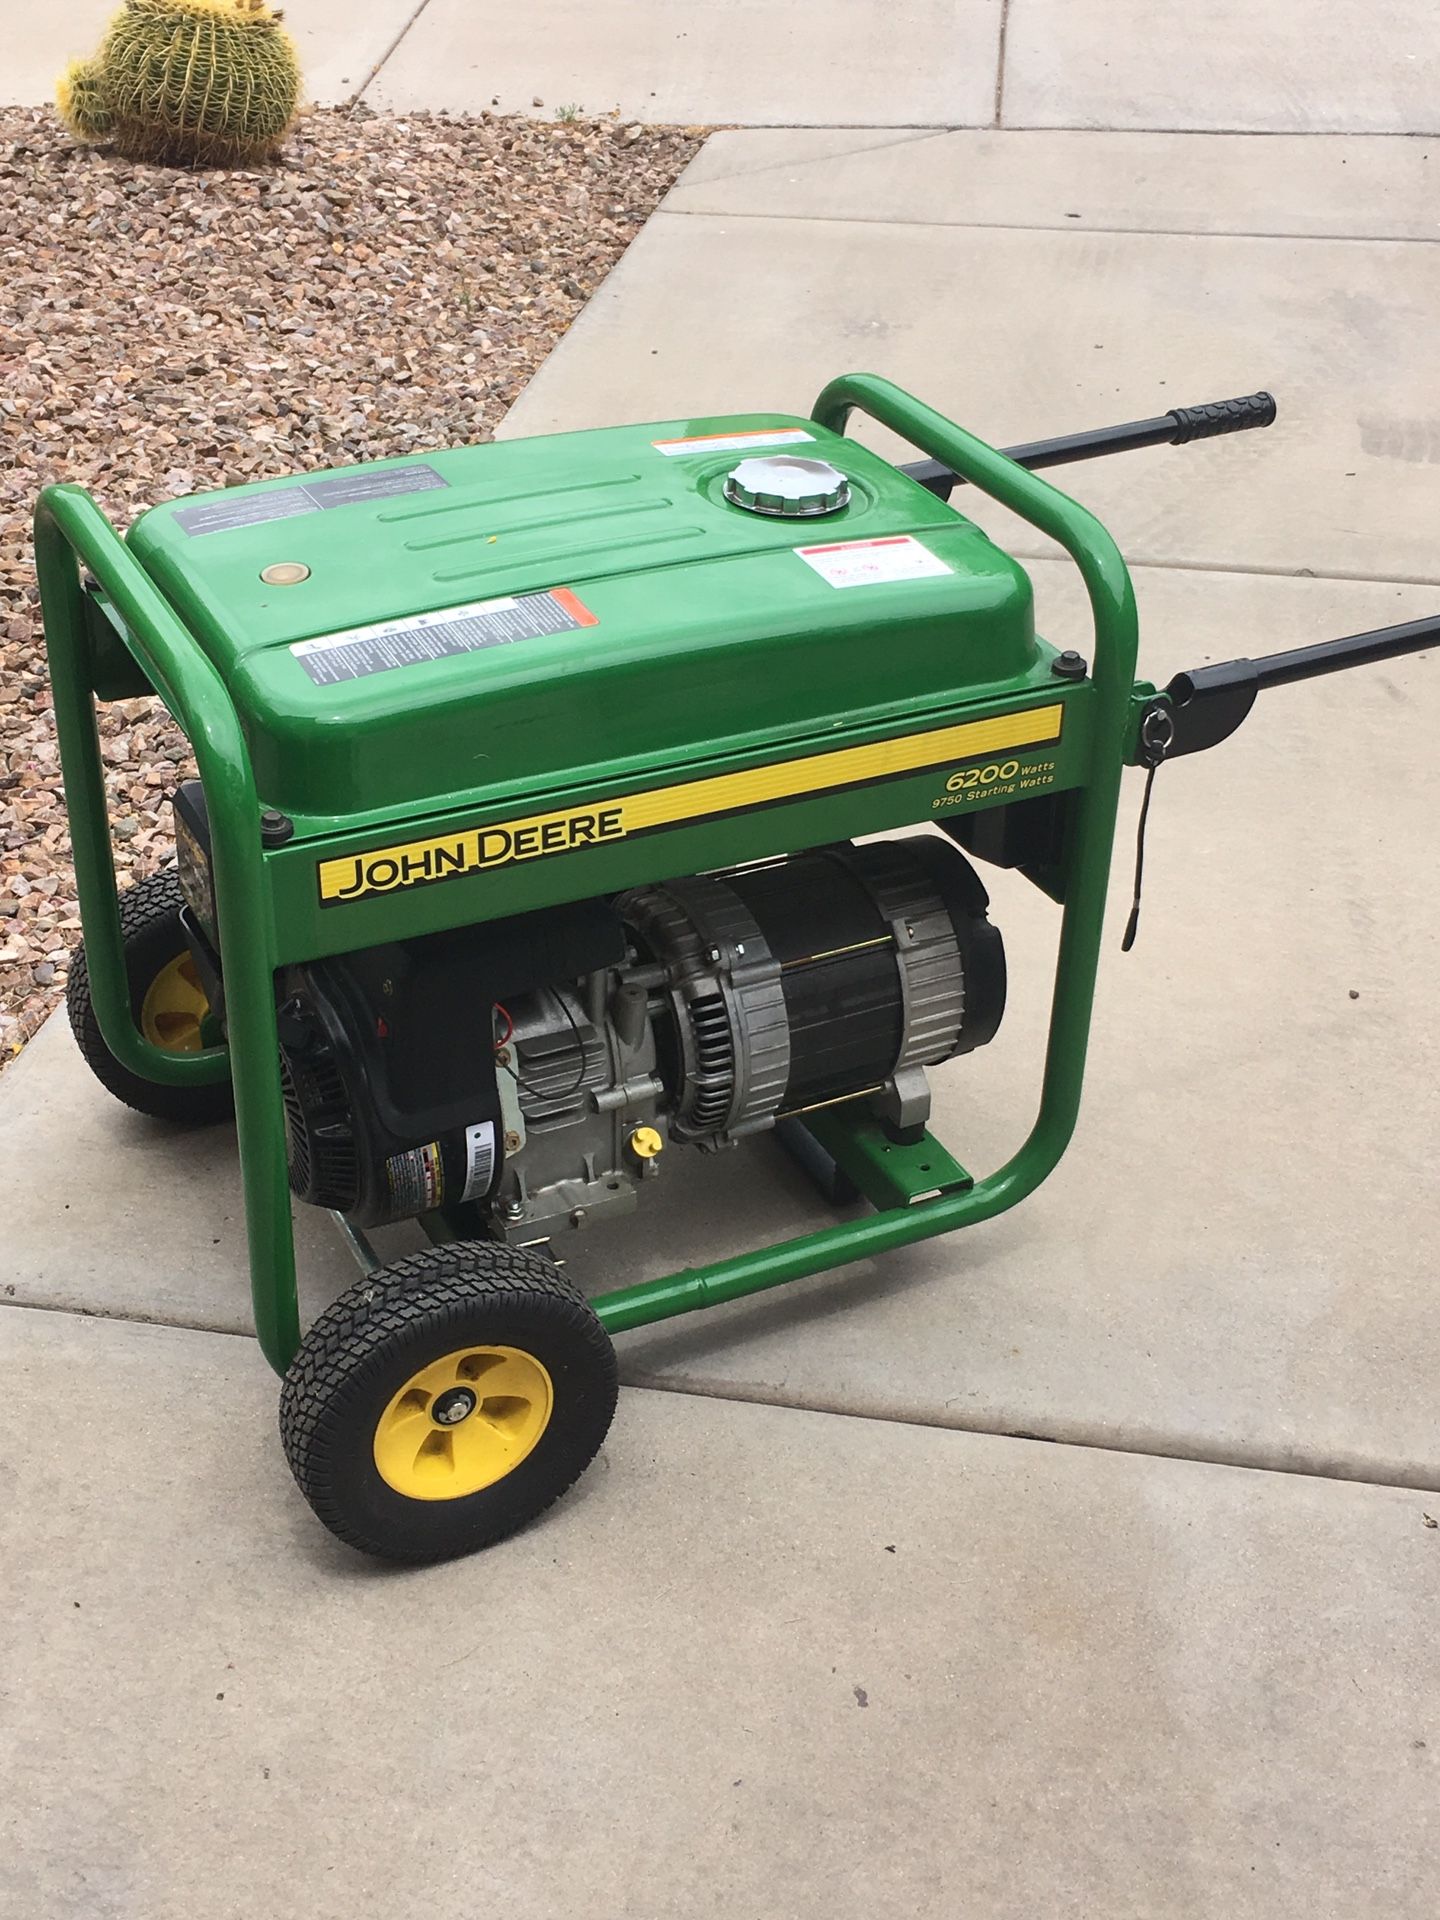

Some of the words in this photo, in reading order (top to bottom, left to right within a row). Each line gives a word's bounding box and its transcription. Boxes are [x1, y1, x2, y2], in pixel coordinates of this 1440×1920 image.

[931, 794, 963, 809] 9750
[966, 782, 1016, 801] Starting
[1020, 774, 1054, 789] Watts
[945, 760, 1020, 792] 6200
[1021, 761, 1055, 776] Watts
[339, 843, 464, 896] JOHN
[478, 808, 623, 864] DEERE
